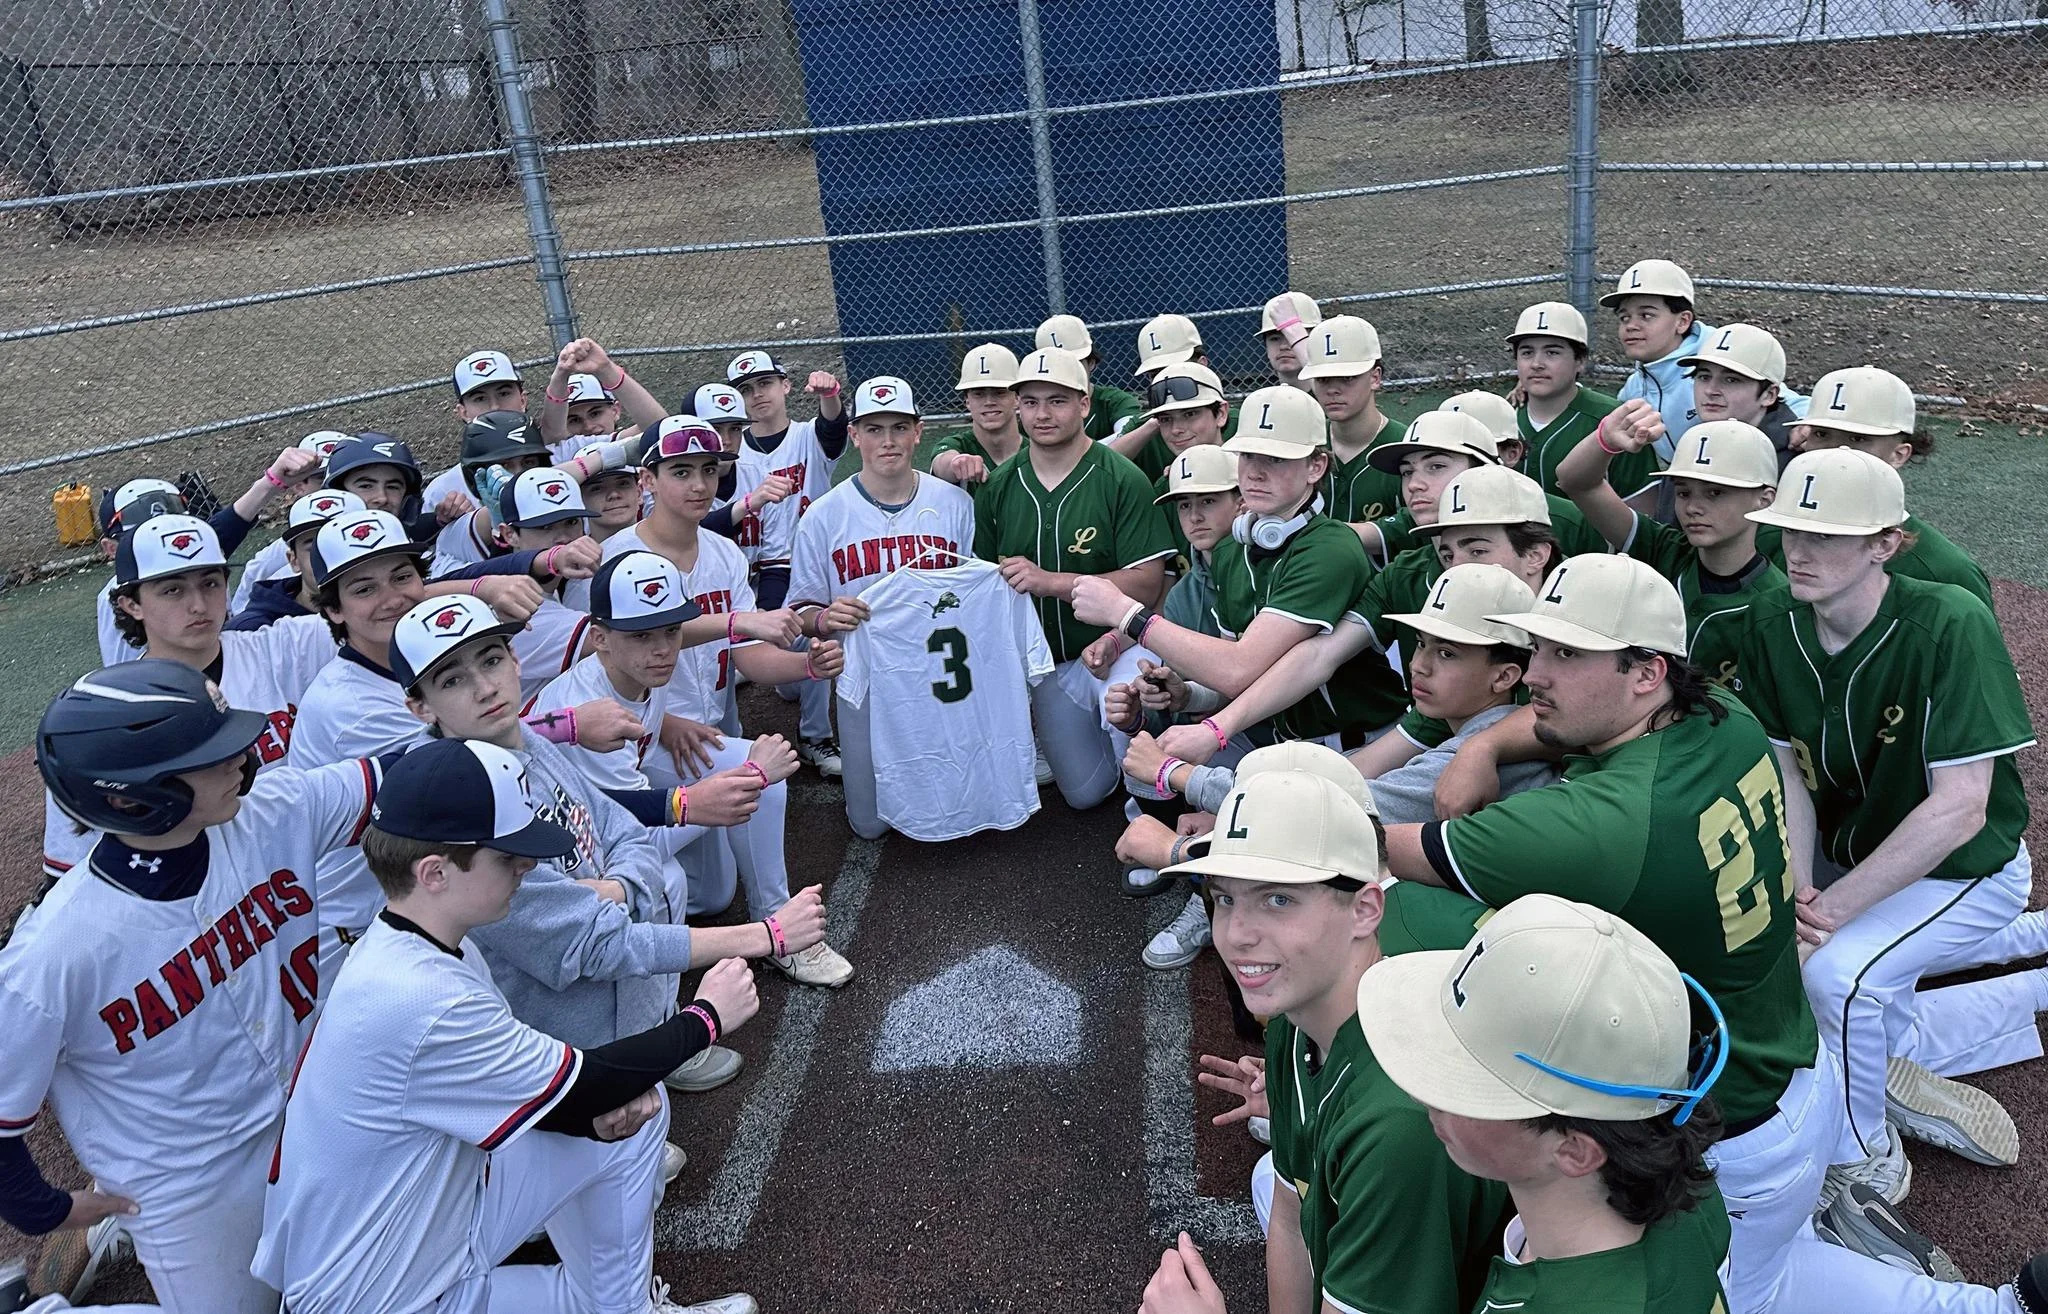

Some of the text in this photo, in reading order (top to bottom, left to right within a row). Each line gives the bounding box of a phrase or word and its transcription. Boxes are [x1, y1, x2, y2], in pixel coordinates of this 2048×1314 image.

[1630, 269, 1642, 288] L
[1536, 311, 1549, 330] L
[1051, 331, 1063, 349] L
[1150, 332, 1162, 351] L
[1325, 334, 1338, 356] L
[1716, 330, 1732, 352] L
[980, 355, 990, 375] L
[1037, 354, 1049, 374] L
[1829, 383, 1847, 411] L
[1258, 403, 1274, 430] L
[1409, 420, 1420, 443] L
[1695, 436, 1711, 465] L
[1181, 457, 1193, 480] L
[1451, 484, 1466, 514] L
[1799, 475, 1819, 510] L
[1067, 526, 1097, 555] L
[831, 534, 958, 586] PANTHERS
[1431, 578, 1450, 611] L
[1544, 567, 1568, 605] L
[925, 625, 974, 705] 3
[1226, 793, 1248, 839] L
[1697, 752, 1796, 953] 27
[98, 868, 313, 1055] PANTHERS
